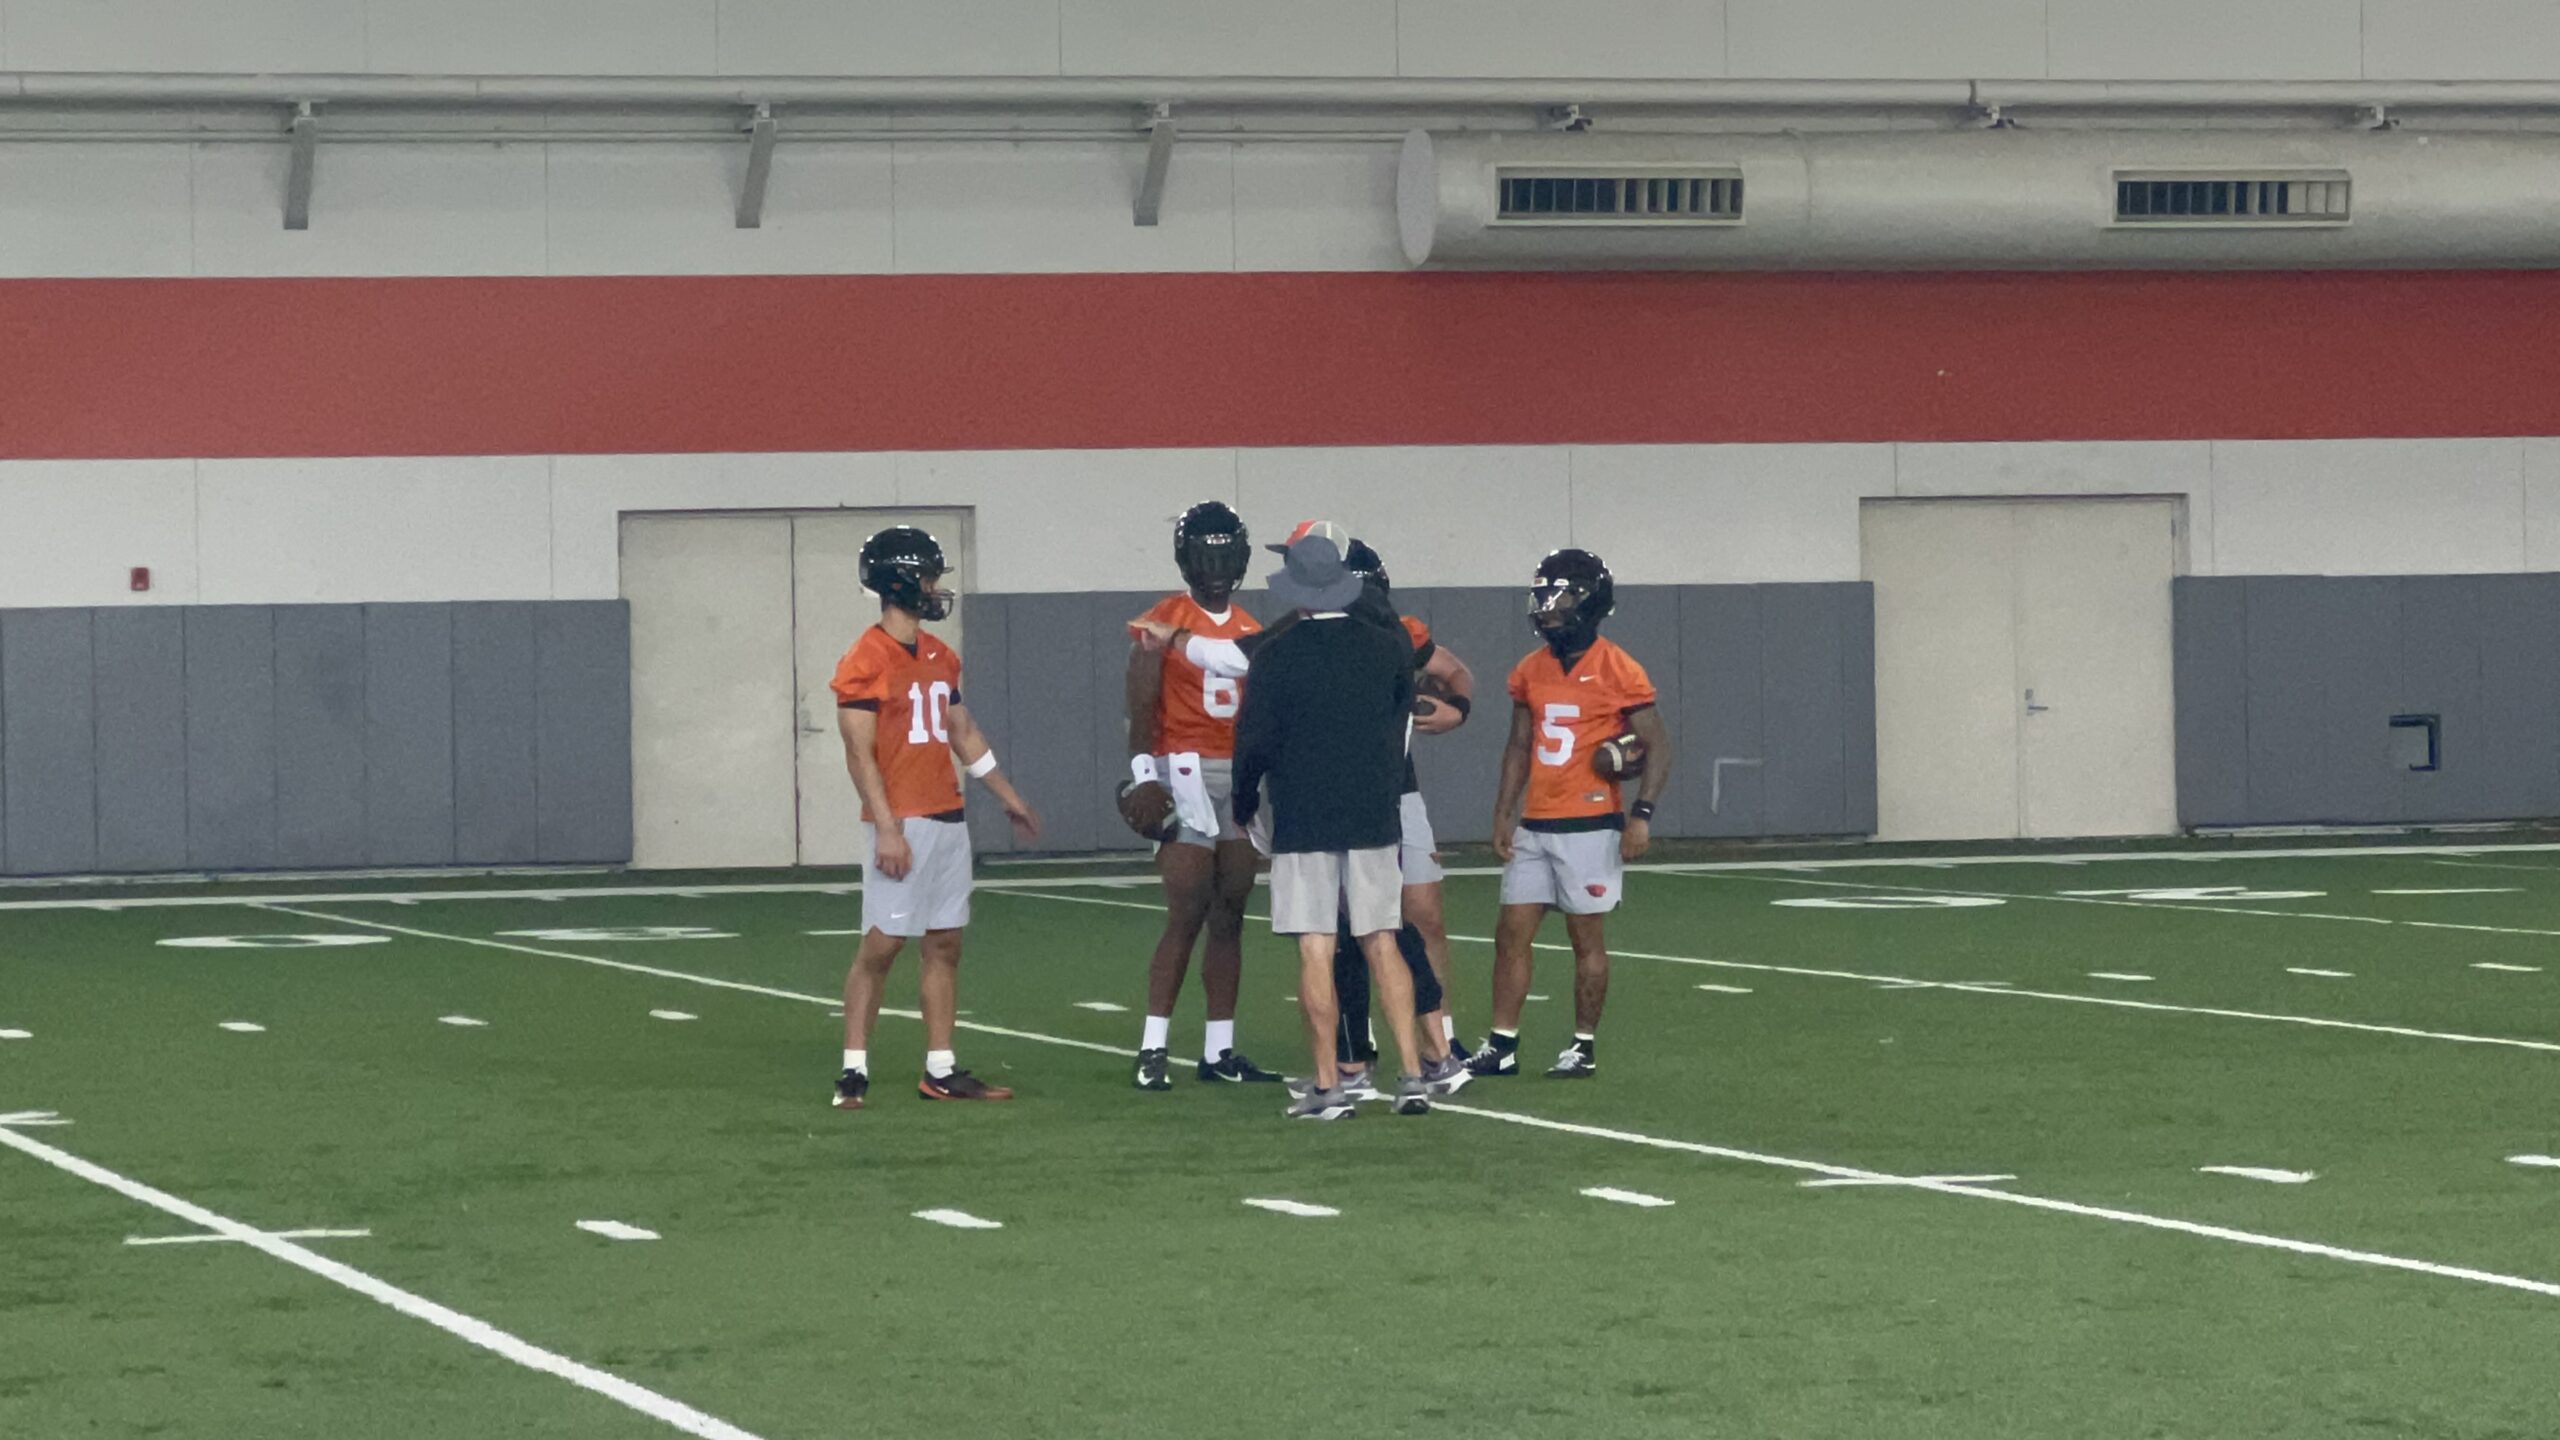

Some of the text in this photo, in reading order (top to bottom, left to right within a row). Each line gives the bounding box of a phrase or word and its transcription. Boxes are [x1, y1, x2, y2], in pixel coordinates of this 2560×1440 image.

[907, 681, 950, 744] 10
[1203, 668, 1239, 718] 6
[1537, 703, 1580, 767] 5
